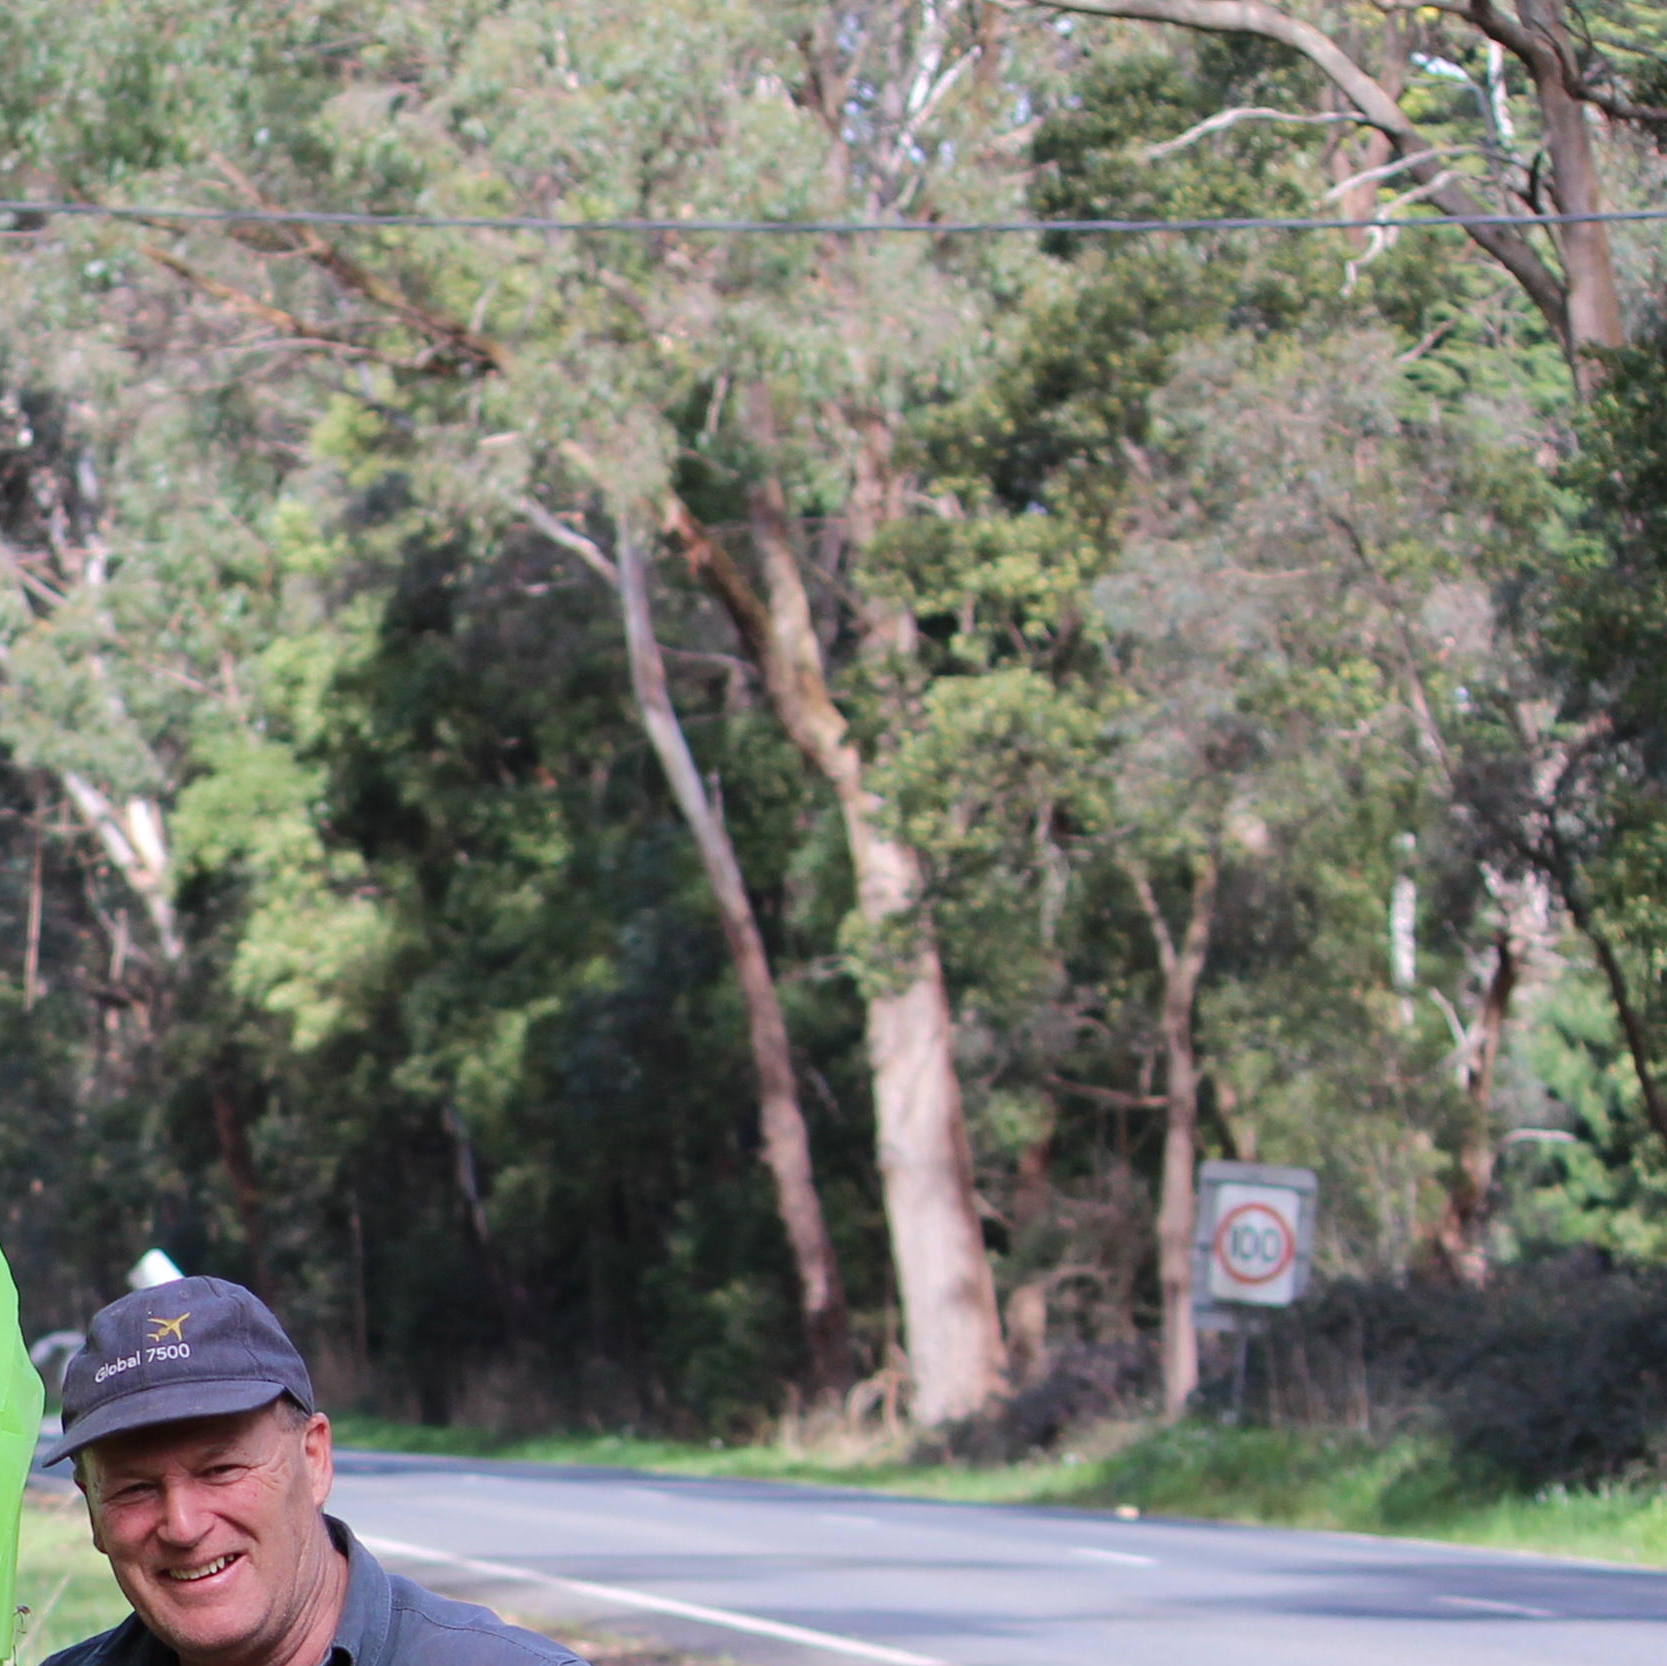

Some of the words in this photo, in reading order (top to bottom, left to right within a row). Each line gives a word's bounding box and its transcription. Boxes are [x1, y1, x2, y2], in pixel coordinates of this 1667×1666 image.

[1230, 1226, 1280, 1262] 100
[95, 1351, 141, 1382] Global
[146, 1343, 190, 1363] 7500
